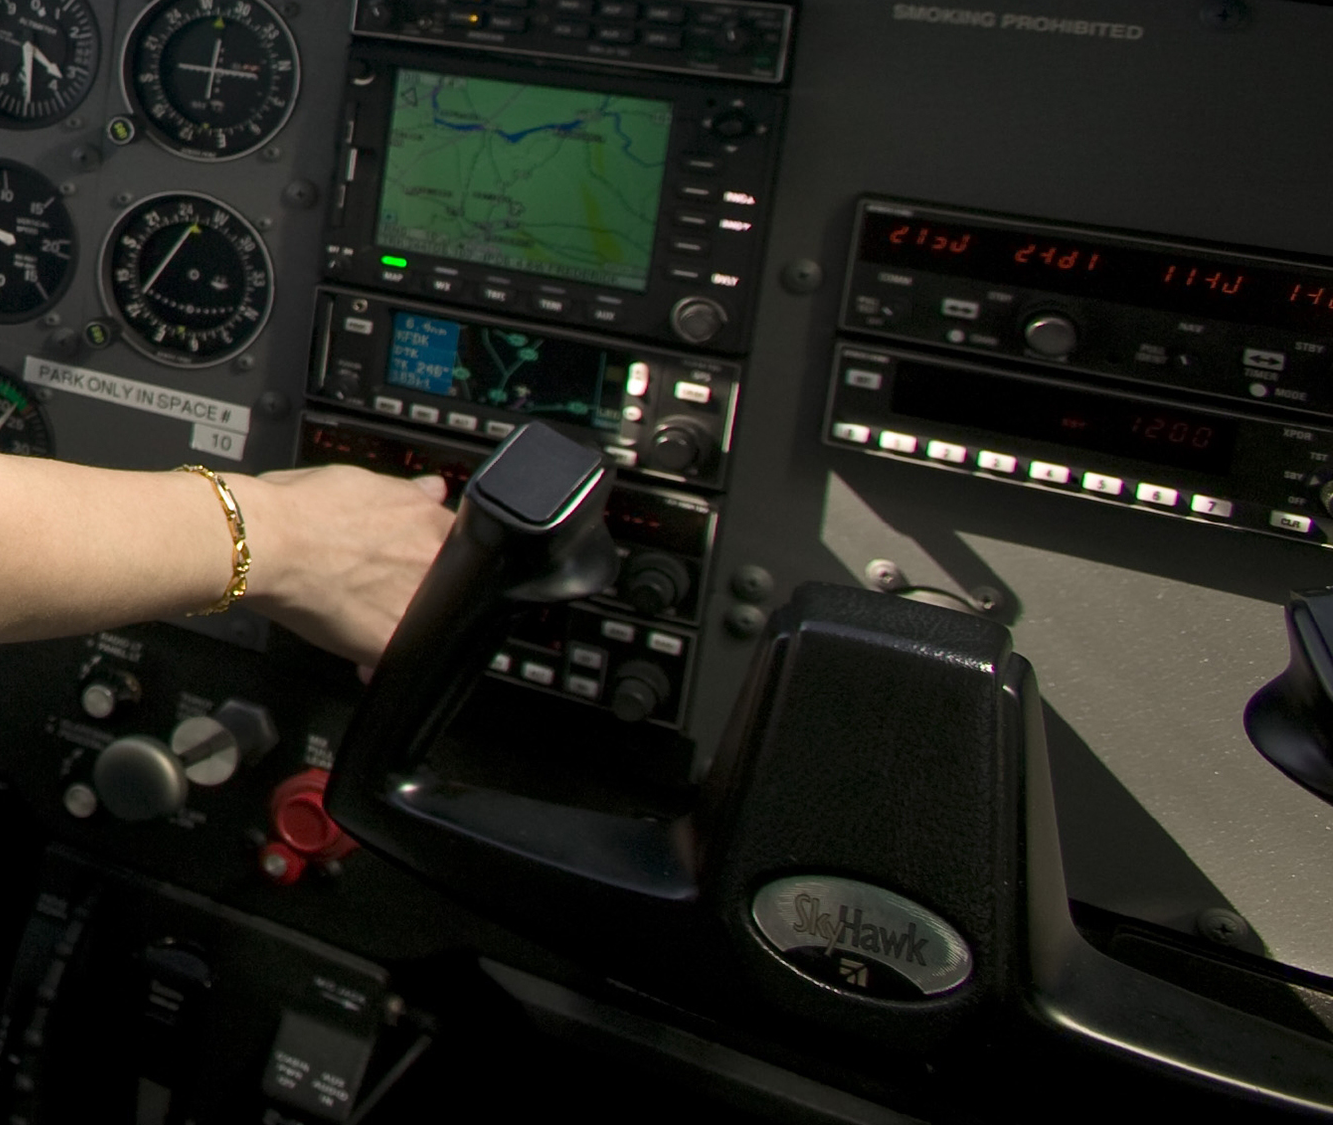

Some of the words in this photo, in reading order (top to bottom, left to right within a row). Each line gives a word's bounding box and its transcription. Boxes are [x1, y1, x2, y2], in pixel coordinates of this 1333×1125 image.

[892, 3, 997, 28] SMOKING
[1000, 12, 1144, 40] PROHIBITED
[0, 188, 14, 203] 10
[30, 201, 44, 216] 15
[41, 239, 61, 254] 20
[1295, 341, 1327, 354] STBY
[39, 364, 84, 390] PARK
[87, 375, 133, 402] ONLY
[136, 388, 154, 407] IN
[157, 394, 218, 422] SPACE
[1274, 387, 1308, 401] MODE
[1132, 416, 1213, 449] 1200
[1284, 428, 1314, 441] XPDR
[211, 432, 233, 451] 10
[1310, 451, 1329, 462] TST
[1152, 490, 1161, 501] 6
[1287, 495, 1308, 507] OFF
[1207, 501, 1216, 512] 7
[793, 893, 929, 966] SkyHawk
